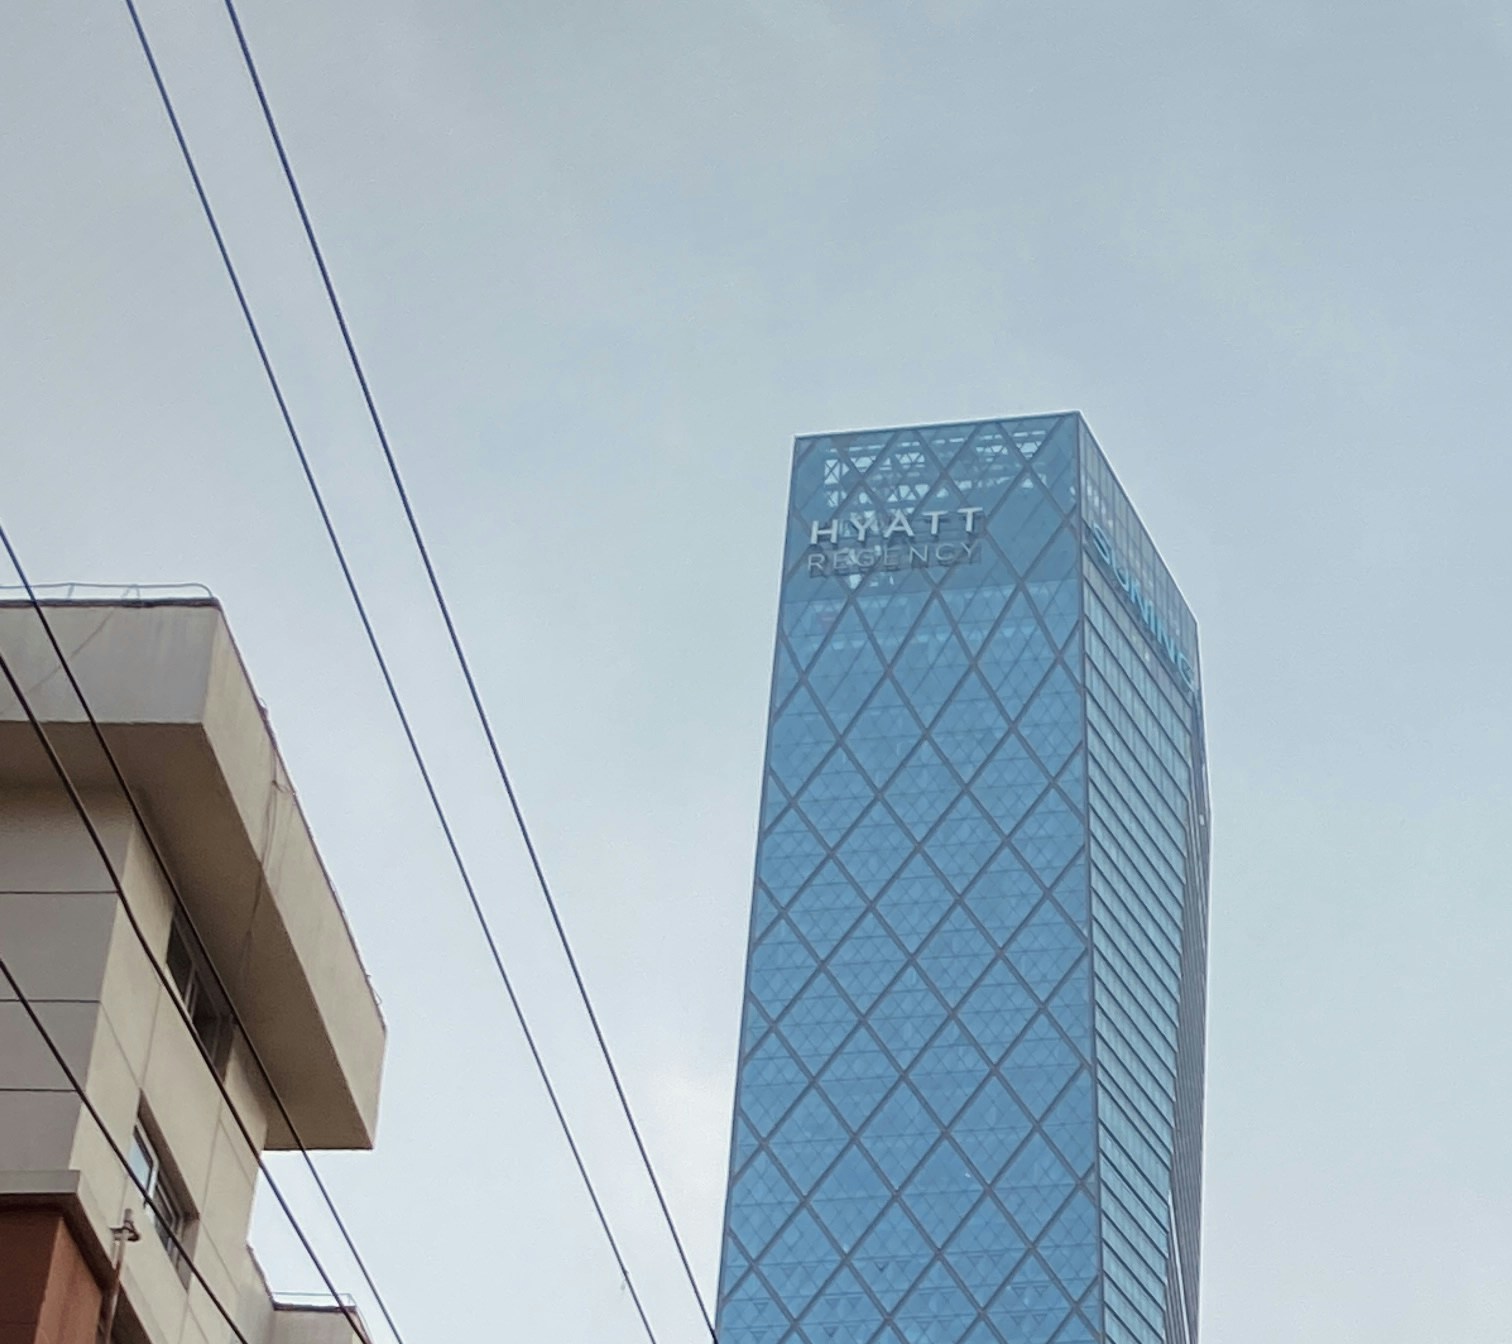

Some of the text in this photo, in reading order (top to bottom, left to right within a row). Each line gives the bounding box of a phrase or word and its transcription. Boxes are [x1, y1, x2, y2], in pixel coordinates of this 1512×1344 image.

[809, 506, 984, 546] HYATT
[807, 541, 979, 572] REGENCY
[1092, 522, 1194, 692] SUNING
